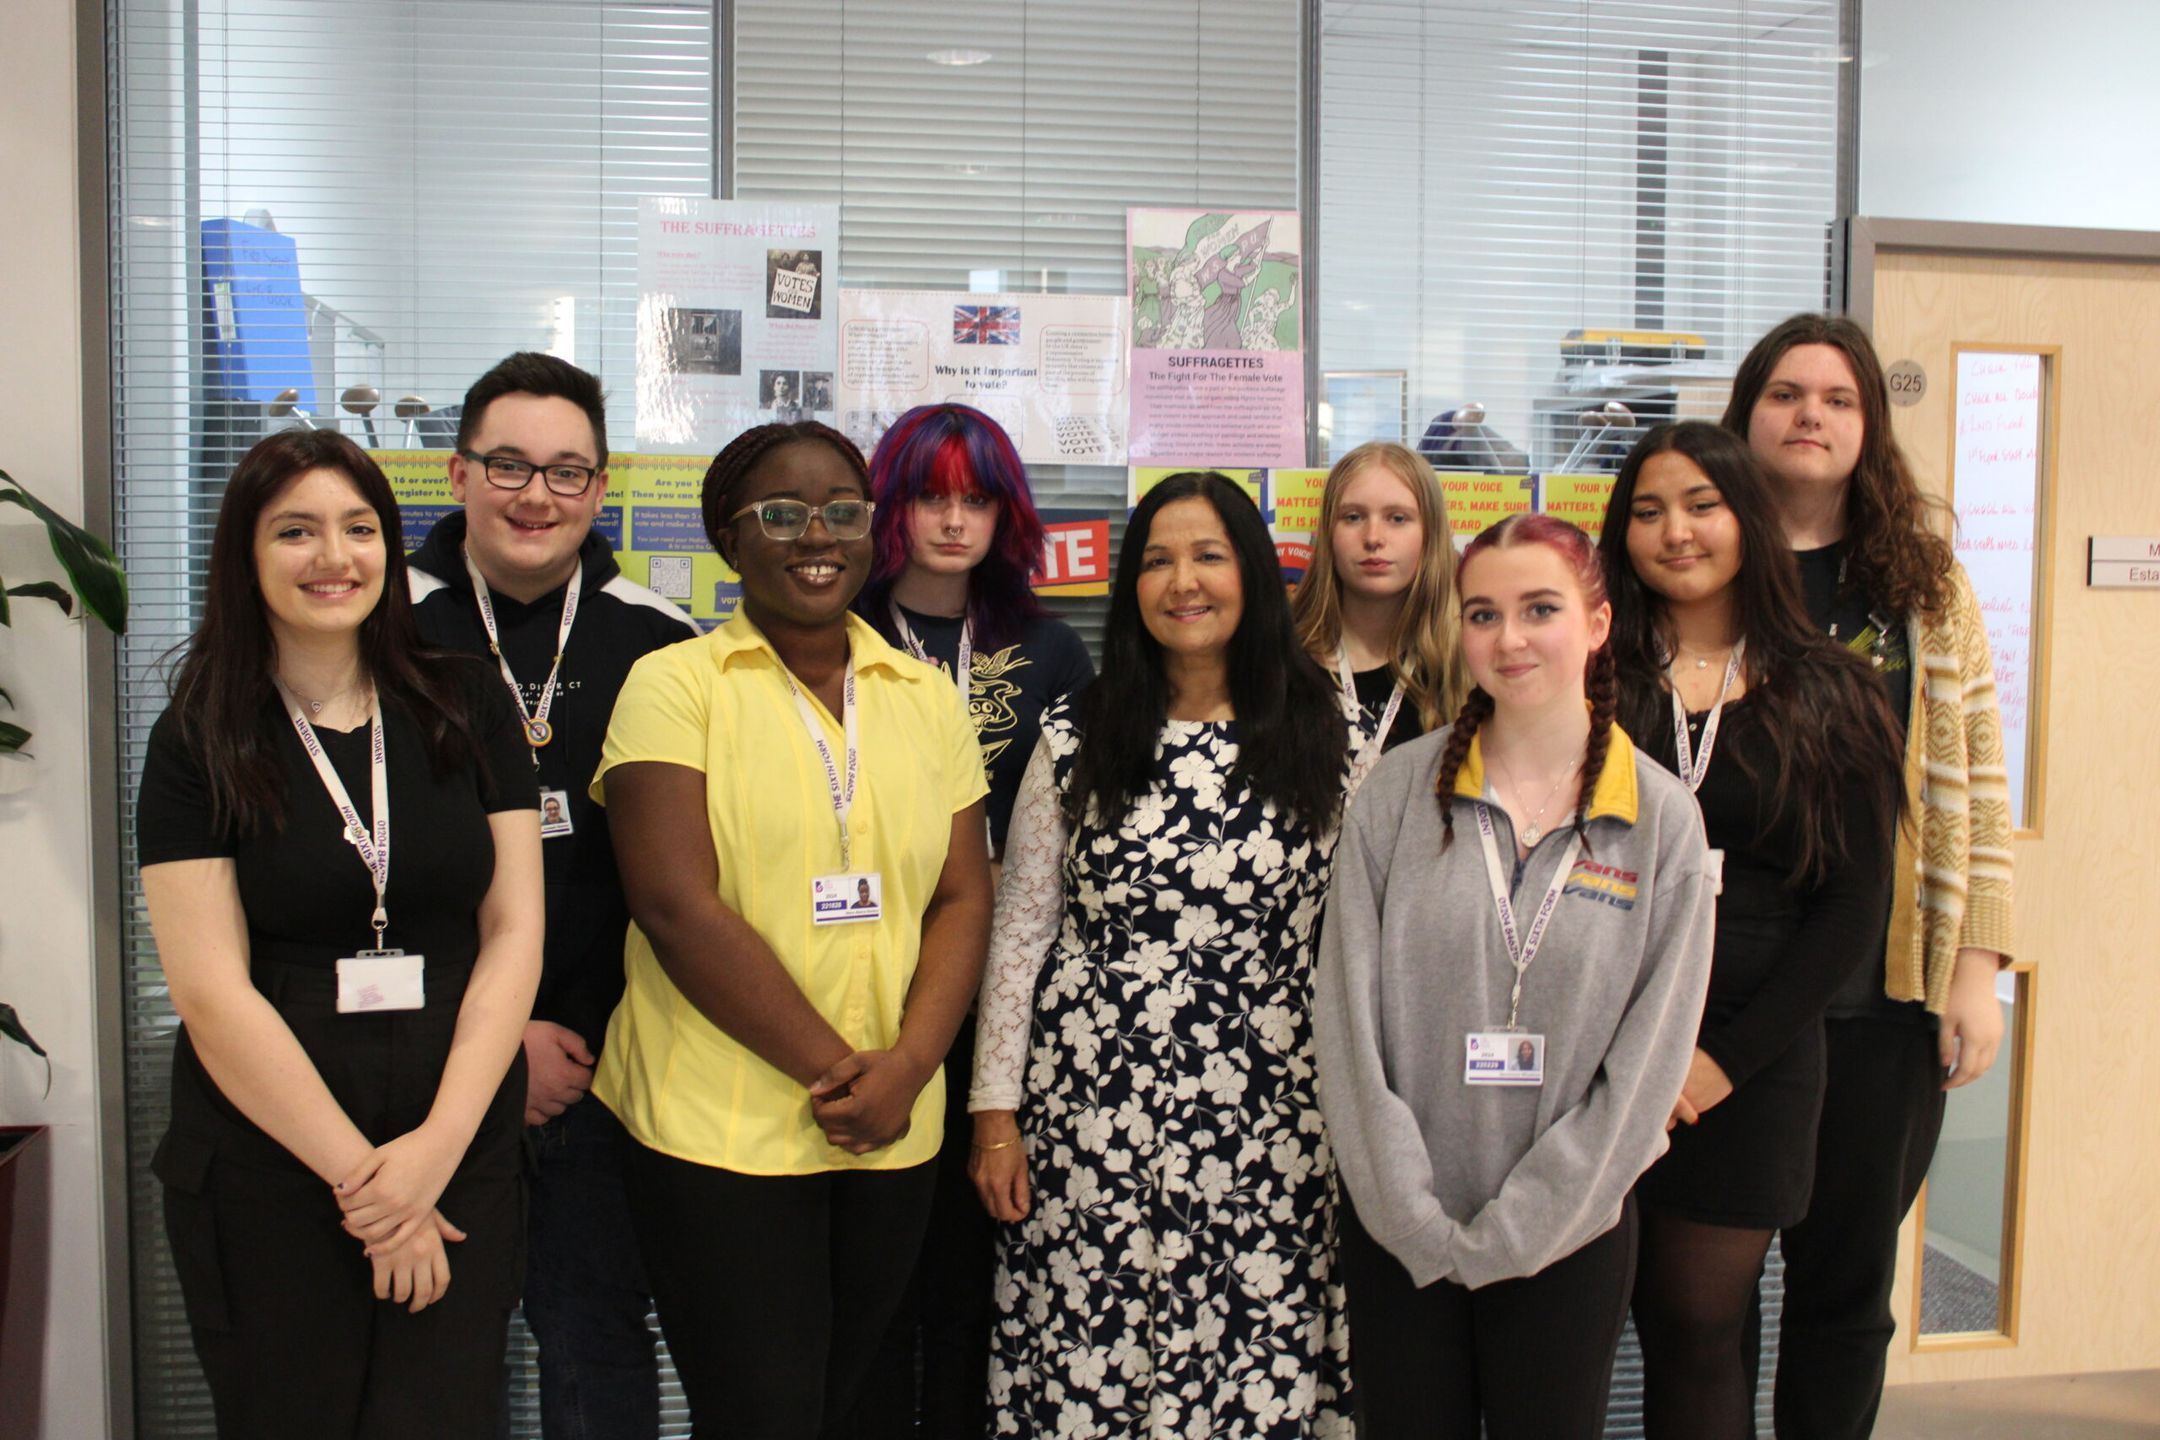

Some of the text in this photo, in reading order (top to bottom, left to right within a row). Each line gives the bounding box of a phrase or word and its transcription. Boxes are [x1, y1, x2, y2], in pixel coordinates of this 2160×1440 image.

[660, 220, 690, 234] THE
[777, 272, 814, 293] VOTES
[772, 290, 812, 309] WOMEN
[1168, 356, 1264, 368] SUFFRAGETTES
[935, 365, 1037, 378] Why is it important
[1149, 371, 1283, 383] The Fight For The Female Vote
[966, 380, 1008, 390] to vote?
[1890, 373, 1922, 393] G25
[655, 479, 672, 487] Are
[1305, 478, 1325, 488] YOU
[1441, 481, 1504, 492] YOUR VOICE
[1573, 483, 1600, 494] YOUR
[395, 489, 433, 498] register
[605, 490, 624, 498] ote!
[632, 490, 654, 498] Then
[657, 492, 674, 500] you
[1276, 497, 1320, 508] MATTER
[1470, 501, 1498, 512] MAKE
[1503, 502, 1529, 512] SURE
[1547, 502, 1597, 513] MATTERS,
[1282, 517, 1306, 527] IT IS
[1043, 529, 1096, 579] TE
[2129, 566, 2160, 582] Esta
[483, 595, 495, 631] STUDENT
[564, 591, 577, 627] STUDENT
[295, 718, 321, 757] STUDENT
[374, 725, 383, 764] STUDENT
[816, 739, 844, 810] THE SIXTH FORM
[342, 805, 359, 826] ORM
[377, 820, 388, 847] 01204
[1529, 918, 1546, 946] SIXTH
[1541, 889, 1557, 916] FORM
